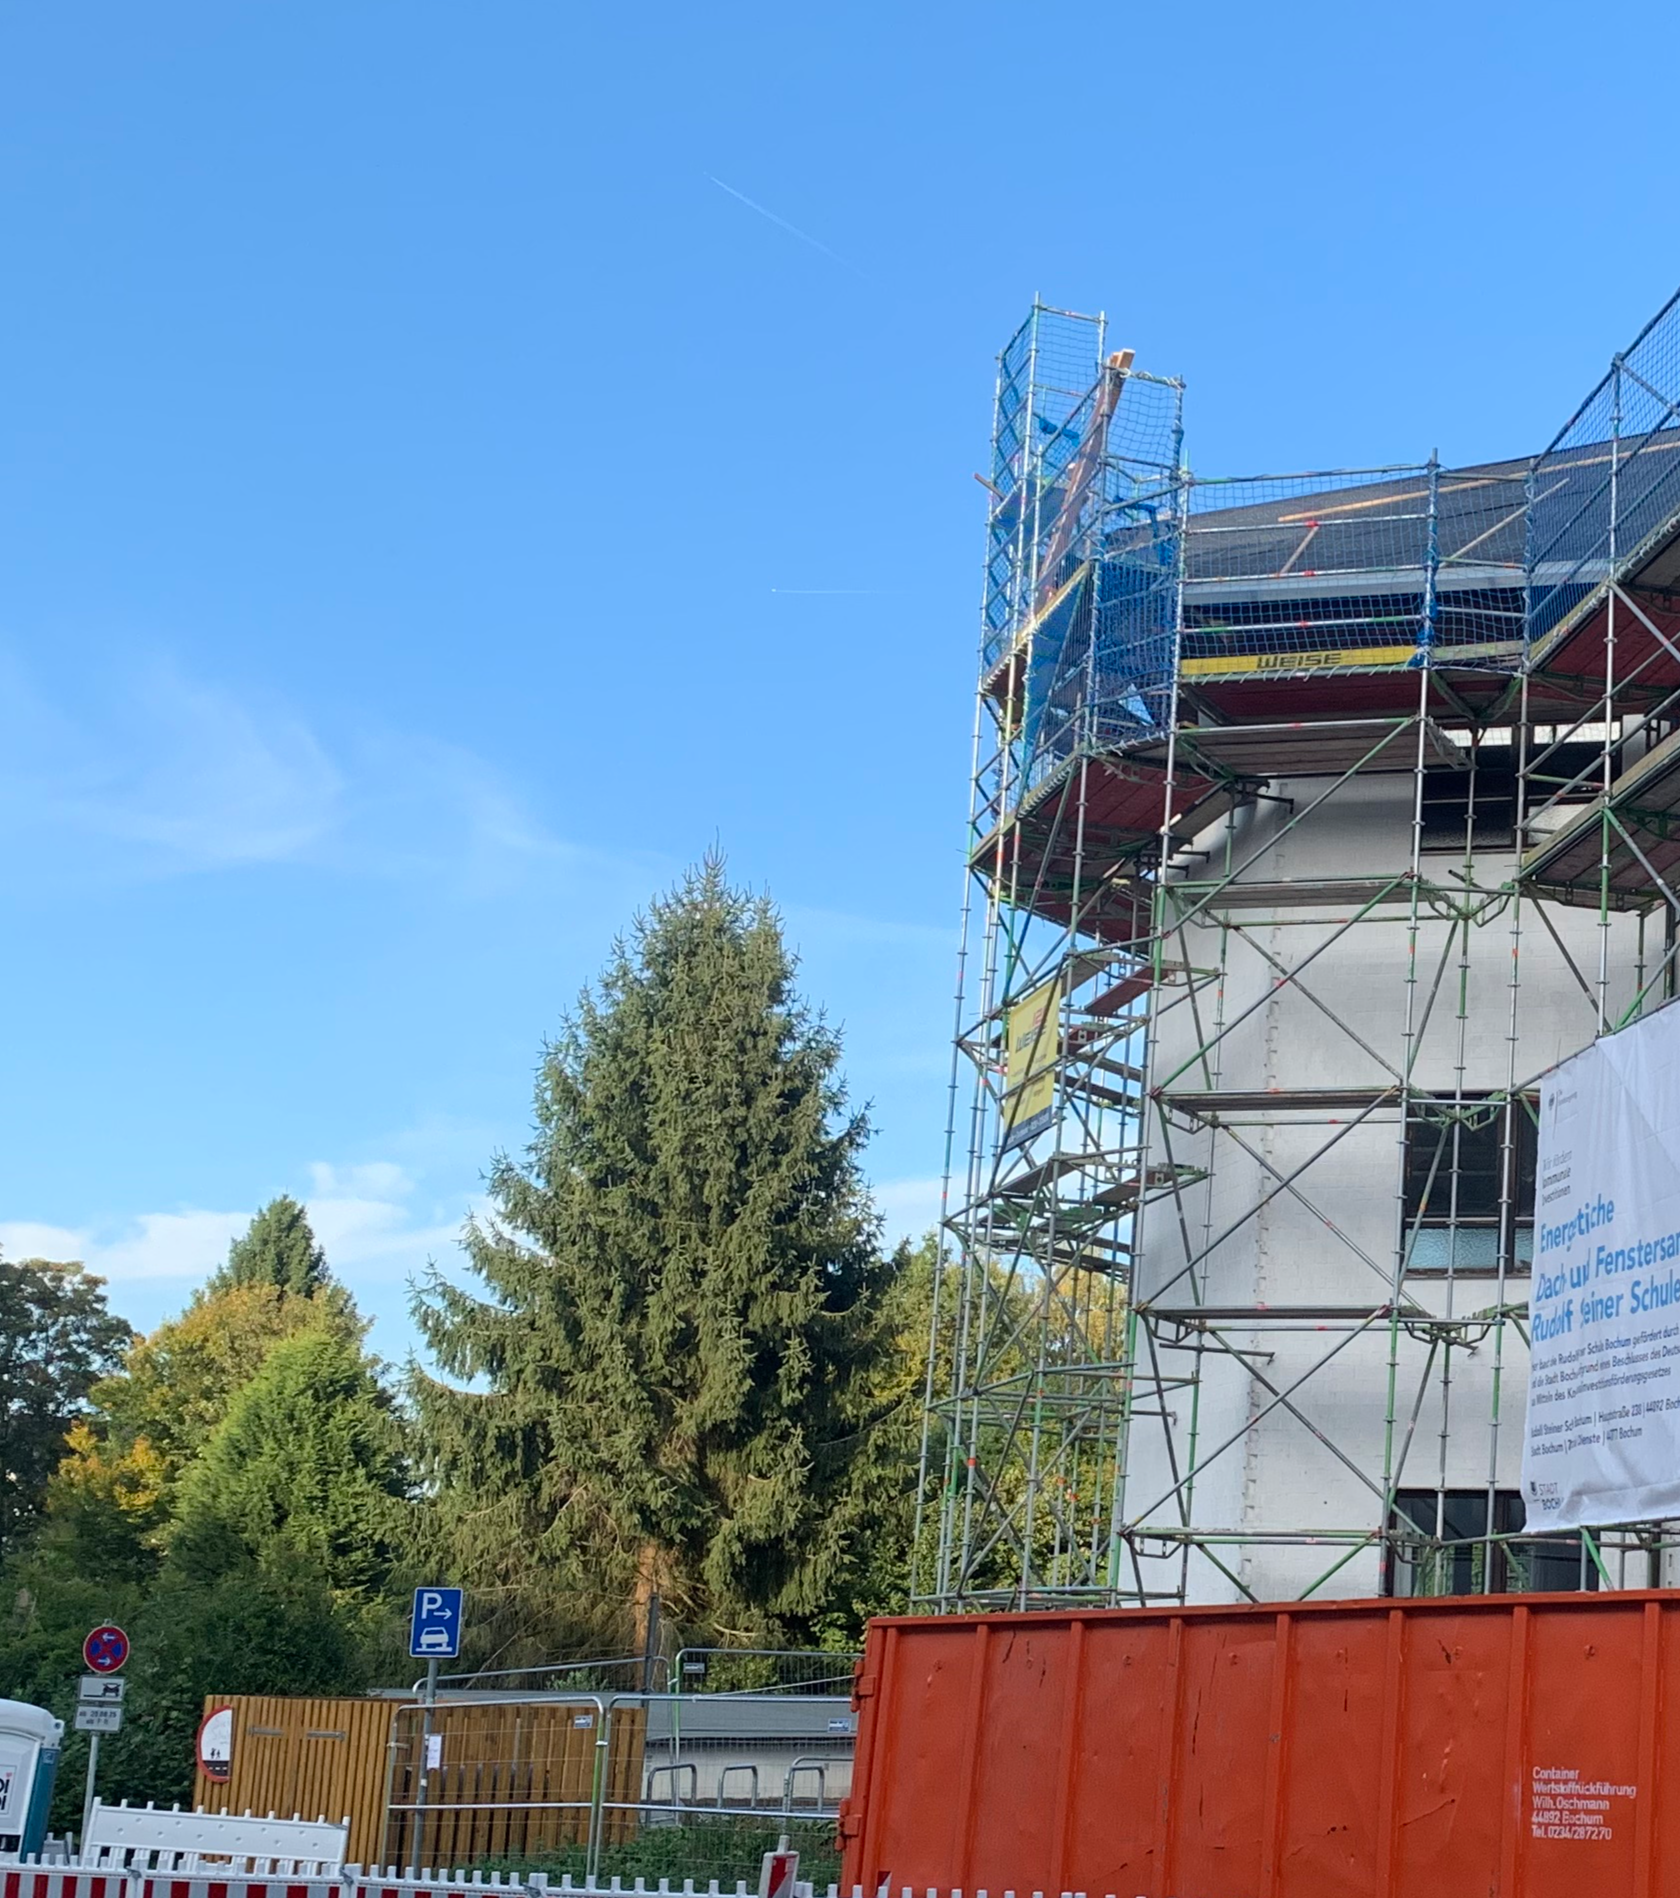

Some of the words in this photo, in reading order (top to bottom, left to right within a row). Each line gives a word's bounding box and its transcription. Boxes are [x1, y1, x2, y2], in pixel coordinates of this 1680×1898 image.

[1257, 653, 1341, 669] WEISE
[1531, 1299, 1573, 1343] Rudolf
[1605, 1337, 1631, 1350] Bochum
[421, 1593, 442, 1619] P
[1532, 1766, 1579, 1779] Container
[1532, 1781, 1636, 1799] Wertstoffrückführung
[1556, 1796, 1610, 1810] Oschmann
[1531, 1810, 1560, 1824] 44892
[1562, 1811, 1603, 1825] Bochum
[1531, 1825, 1546, 1838] Tel.
